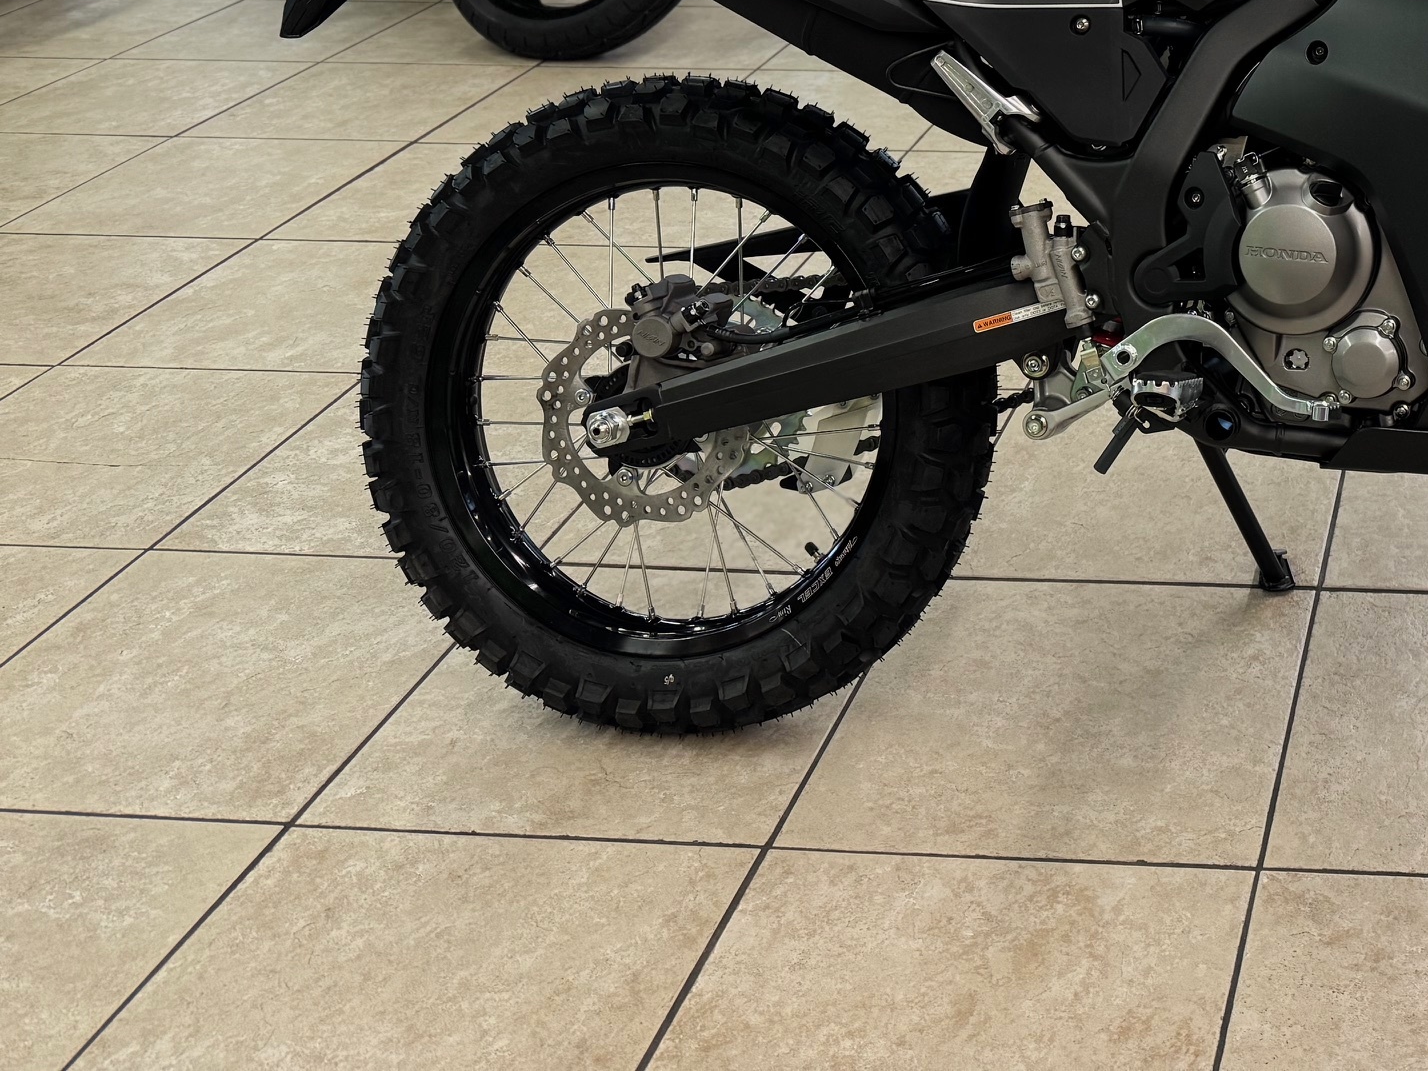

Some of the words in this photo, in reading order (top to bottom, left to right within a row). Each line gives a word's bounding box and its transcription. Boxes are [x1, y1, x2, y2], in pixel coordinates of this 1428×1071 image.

[1245, 245, 1329, 264] HONDA
[983, 312, 1012, 328] WARNING
[797, 566, 834, 603] EXCEL
